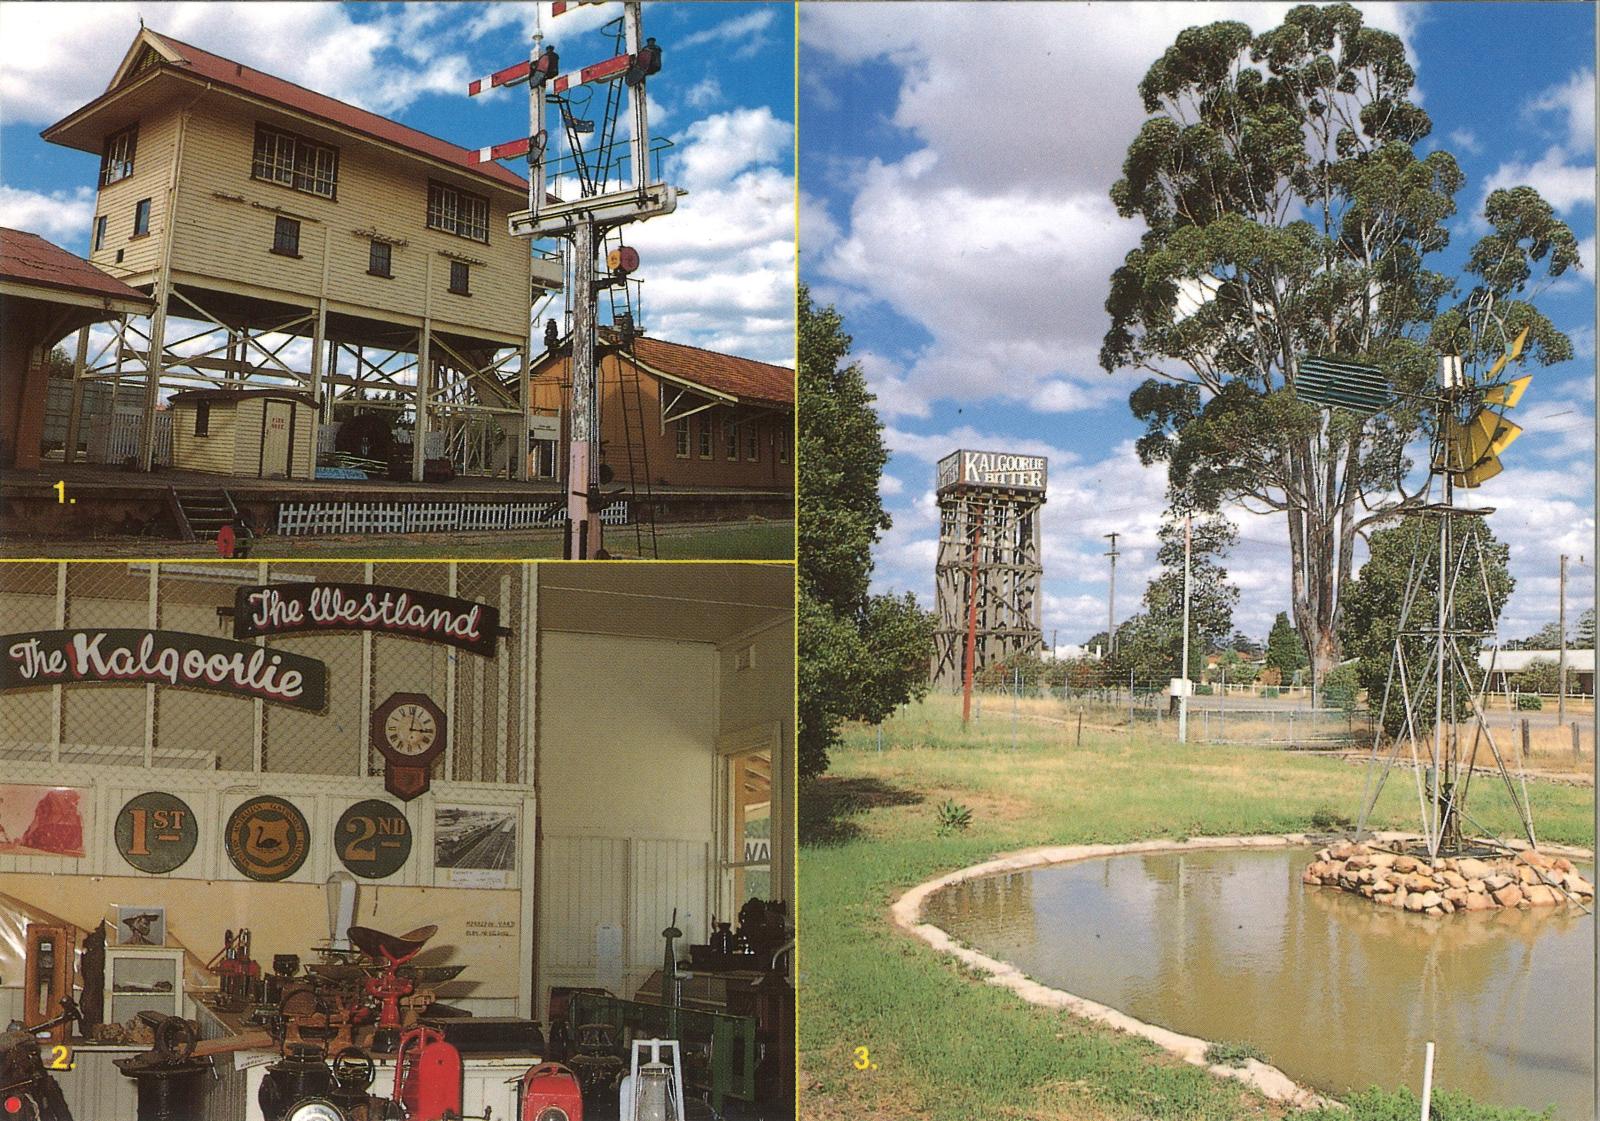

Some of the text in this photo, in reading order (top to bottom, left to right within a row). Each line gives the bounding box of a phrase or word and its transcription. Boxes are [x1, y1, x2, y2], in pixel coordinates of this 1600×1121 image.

[964, 451, 1044, 482] KALGOORLIE
[984, 471, 1043, 487] BITTER
[248, 587, 480, 638] The Westland
[9, 632, 303, 698] The Kalgoorlie
